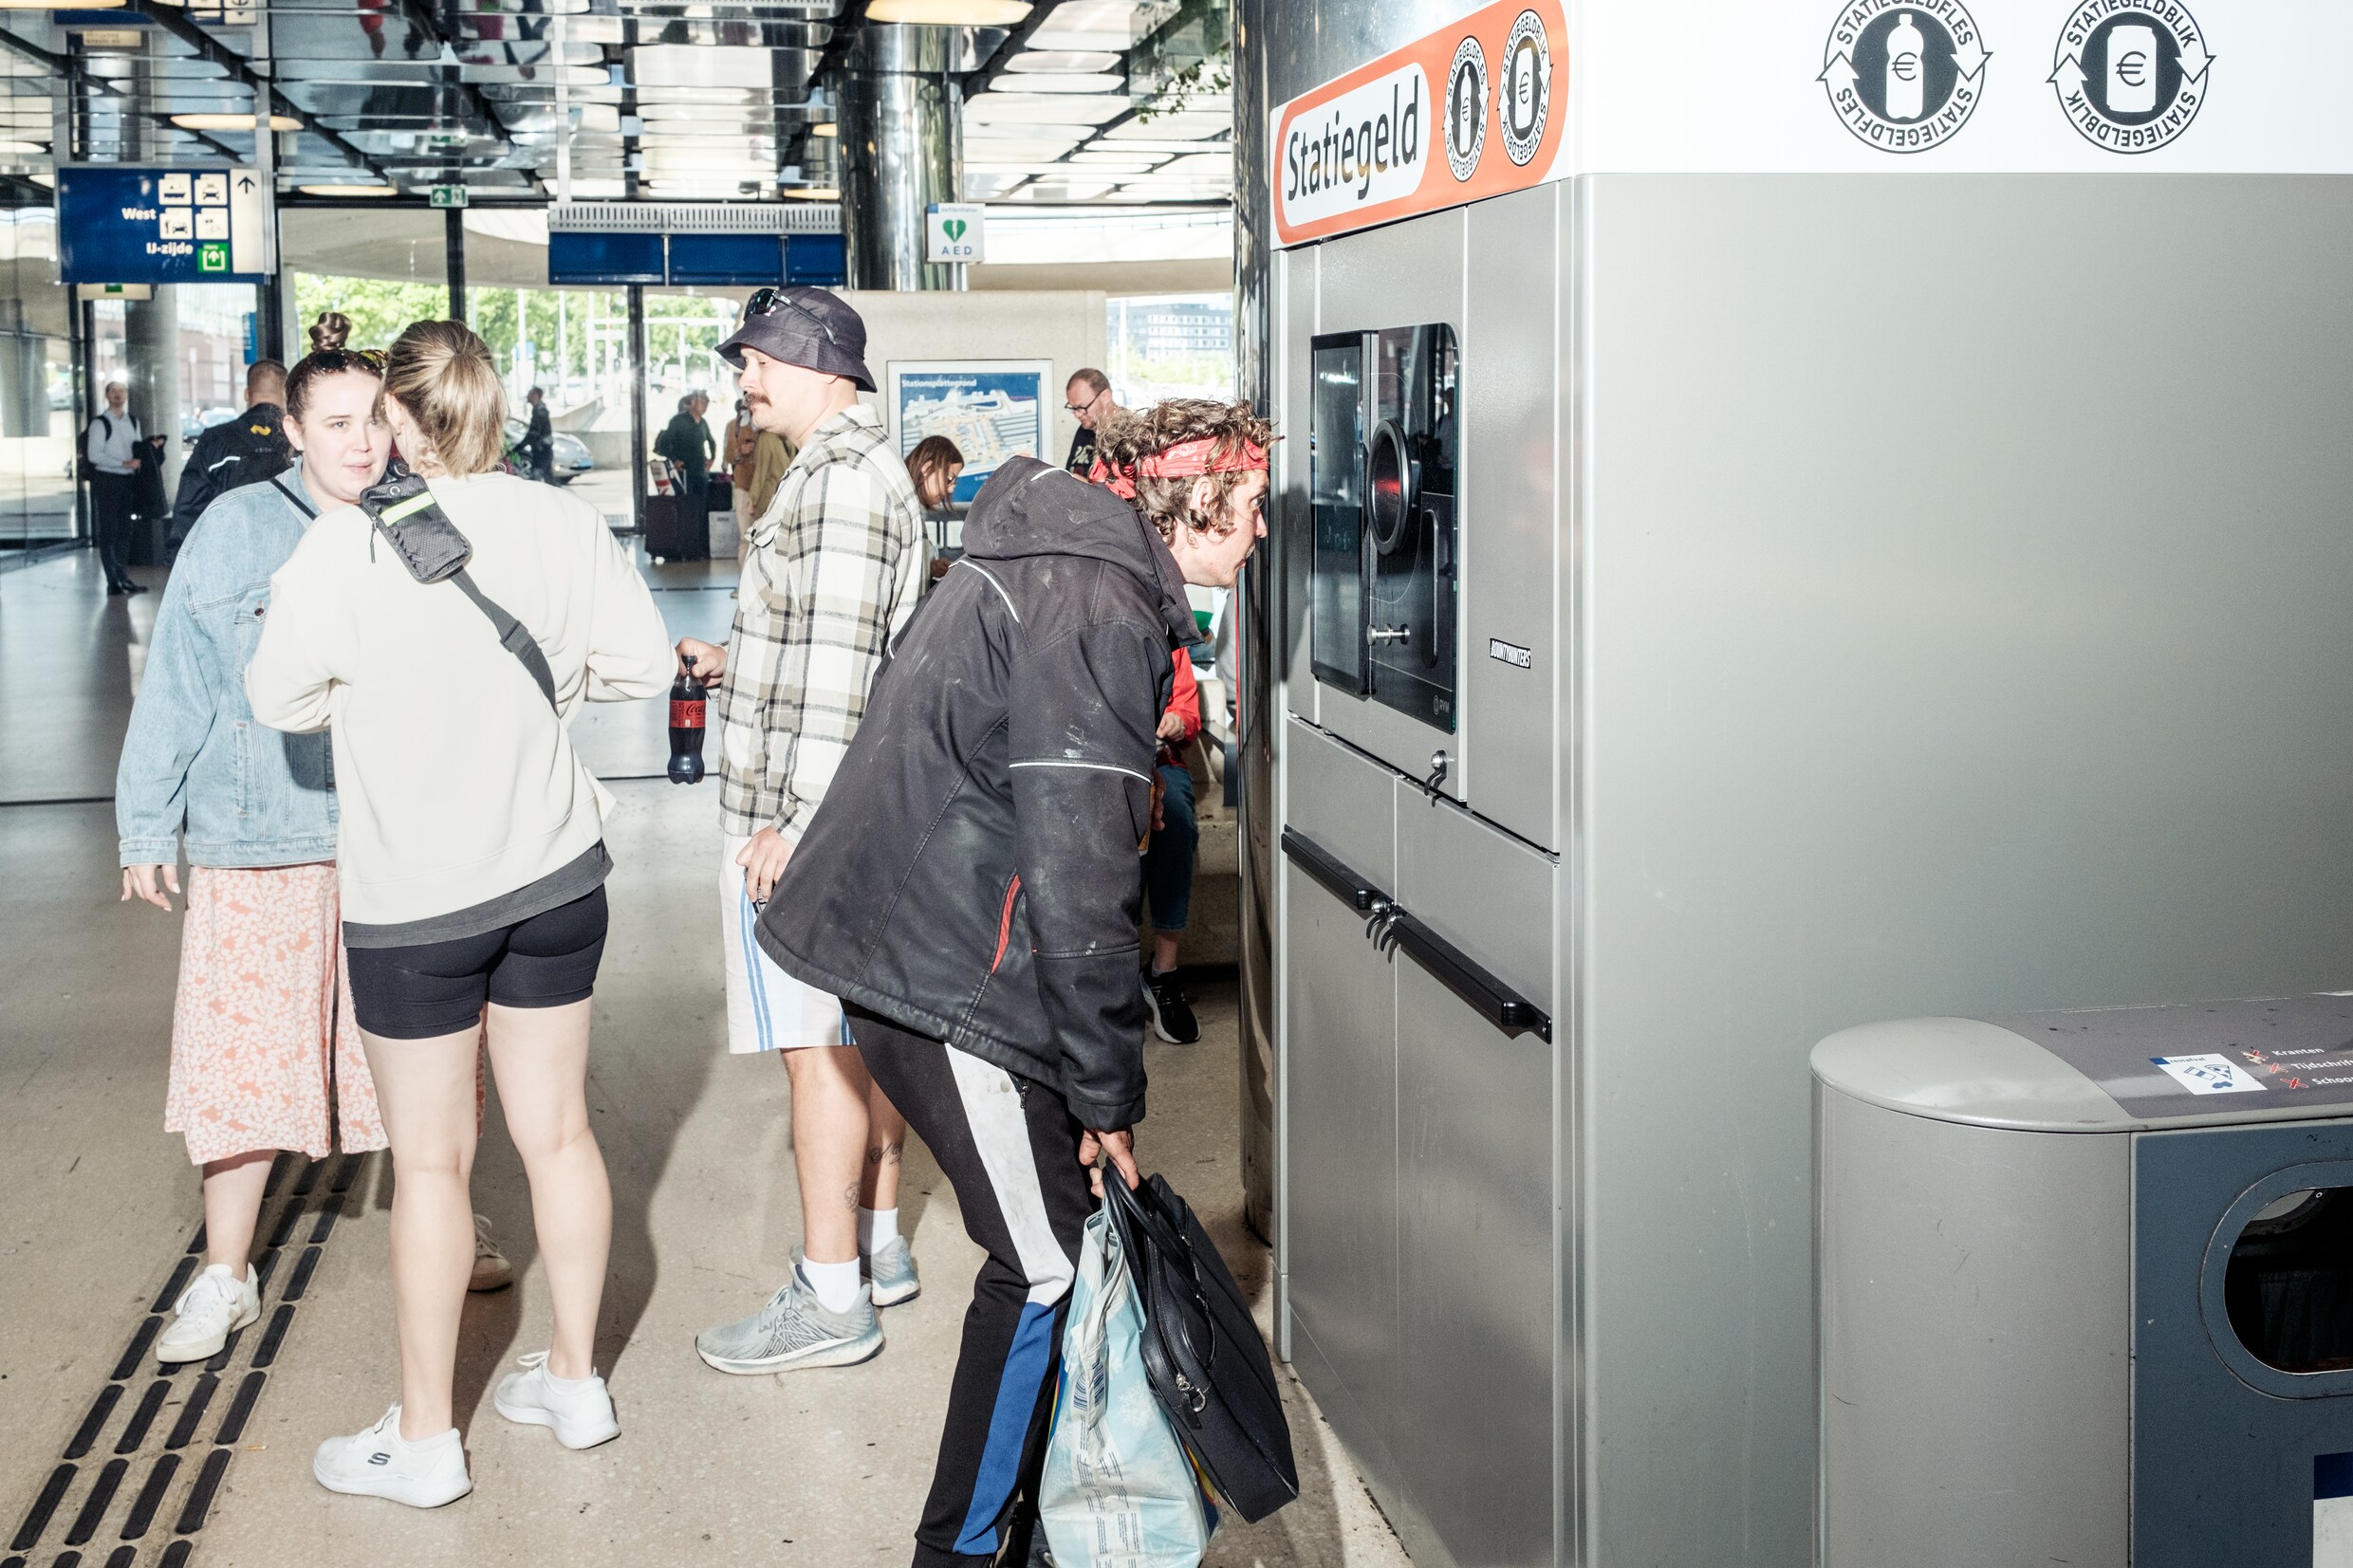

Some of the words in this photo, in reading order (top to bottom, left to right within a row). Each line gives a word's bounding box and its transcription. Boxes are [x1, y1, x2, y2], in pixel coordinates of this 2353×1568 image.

[1837, 0, 1973, 46] STATIEDFLES
[1503, 14, 1547, 75] STATIEGELDBLIK
[1448, 42, 1487, 98] STATIEGELDFLES
[1891, 51, 1918, 82] €
[2116, 50, 2147, 86] €
[1288, 74, 1419, 201] Statiegeld
[1502, 102, 1547, 160] STATIEGELDBLIK
[1836, 87, 1973, 147] STATIEGELDFLES
[2065, 90, 2196, 148] STATIEGELDBLIK
[1447, 121, 1485, 176] STATIEGELDFLES
[121, 208, 157, 220] West
[146, 242, 194, 257] IJ-zijde
[941, 246, 973, 255] AED
[901, 379, 977, 389] Stationsplattegrond
[2272, 1047, 2325, 1057] Kranten
[2312, 1077, 2353, 1085] Schoo
